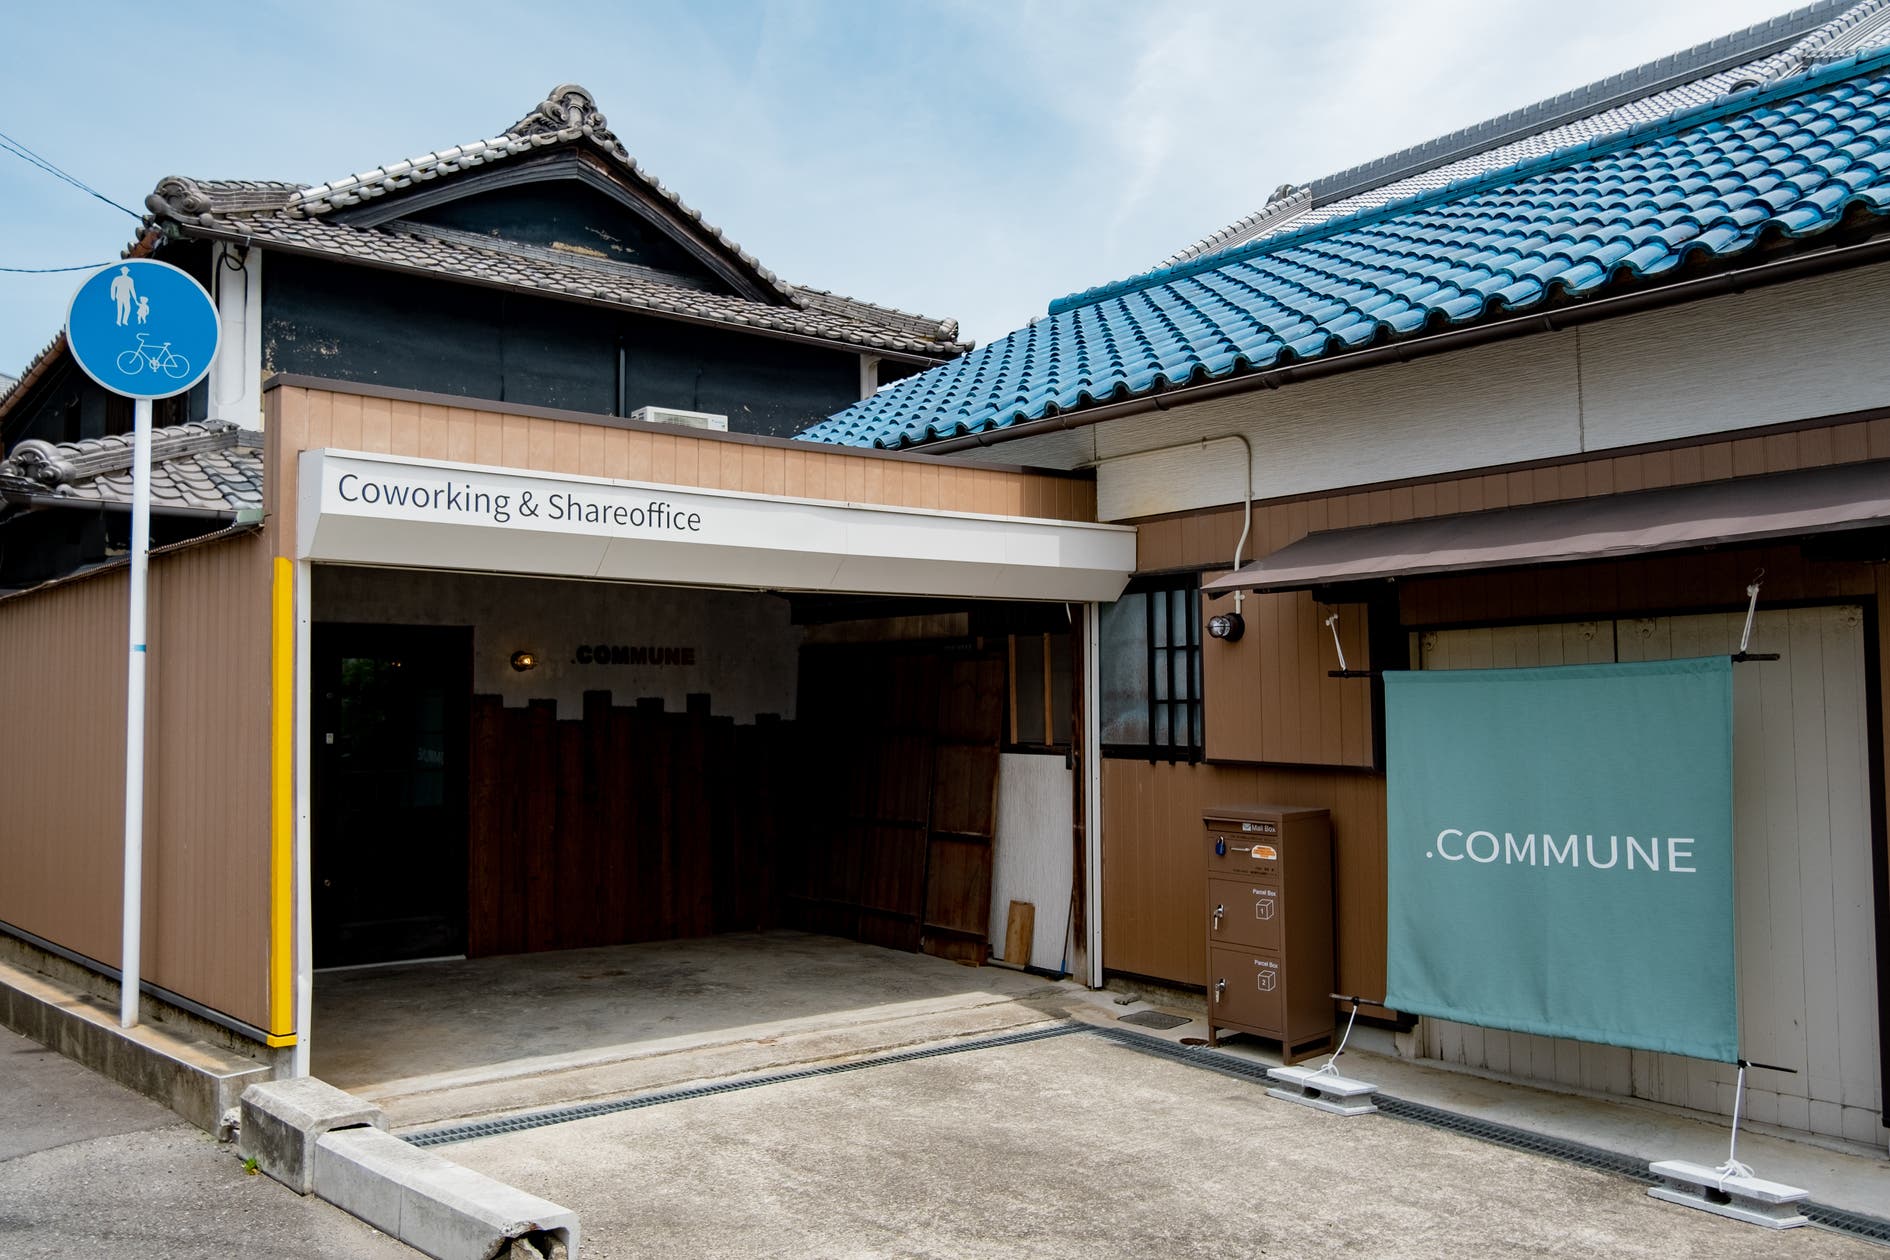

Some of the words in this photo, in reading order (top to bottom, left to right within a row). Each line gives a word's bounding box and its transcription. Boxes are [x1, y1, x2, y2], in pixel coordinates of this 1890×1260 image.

[338, 474, 511, 523] Coworking
[519, 490, 539, 518] &
[548, 493, 701, 531] Shareoffice
[570, 645, 696, 665] .COMMUNE
[1251, 823, 1264, 832] Mail
[1264, 825, 1276, 833] Box
[1426, 828, 1697, 873] .COMMUNE
[1267, 889, 1277, 897] Box
[1269, 961, 1278, 969] Box
